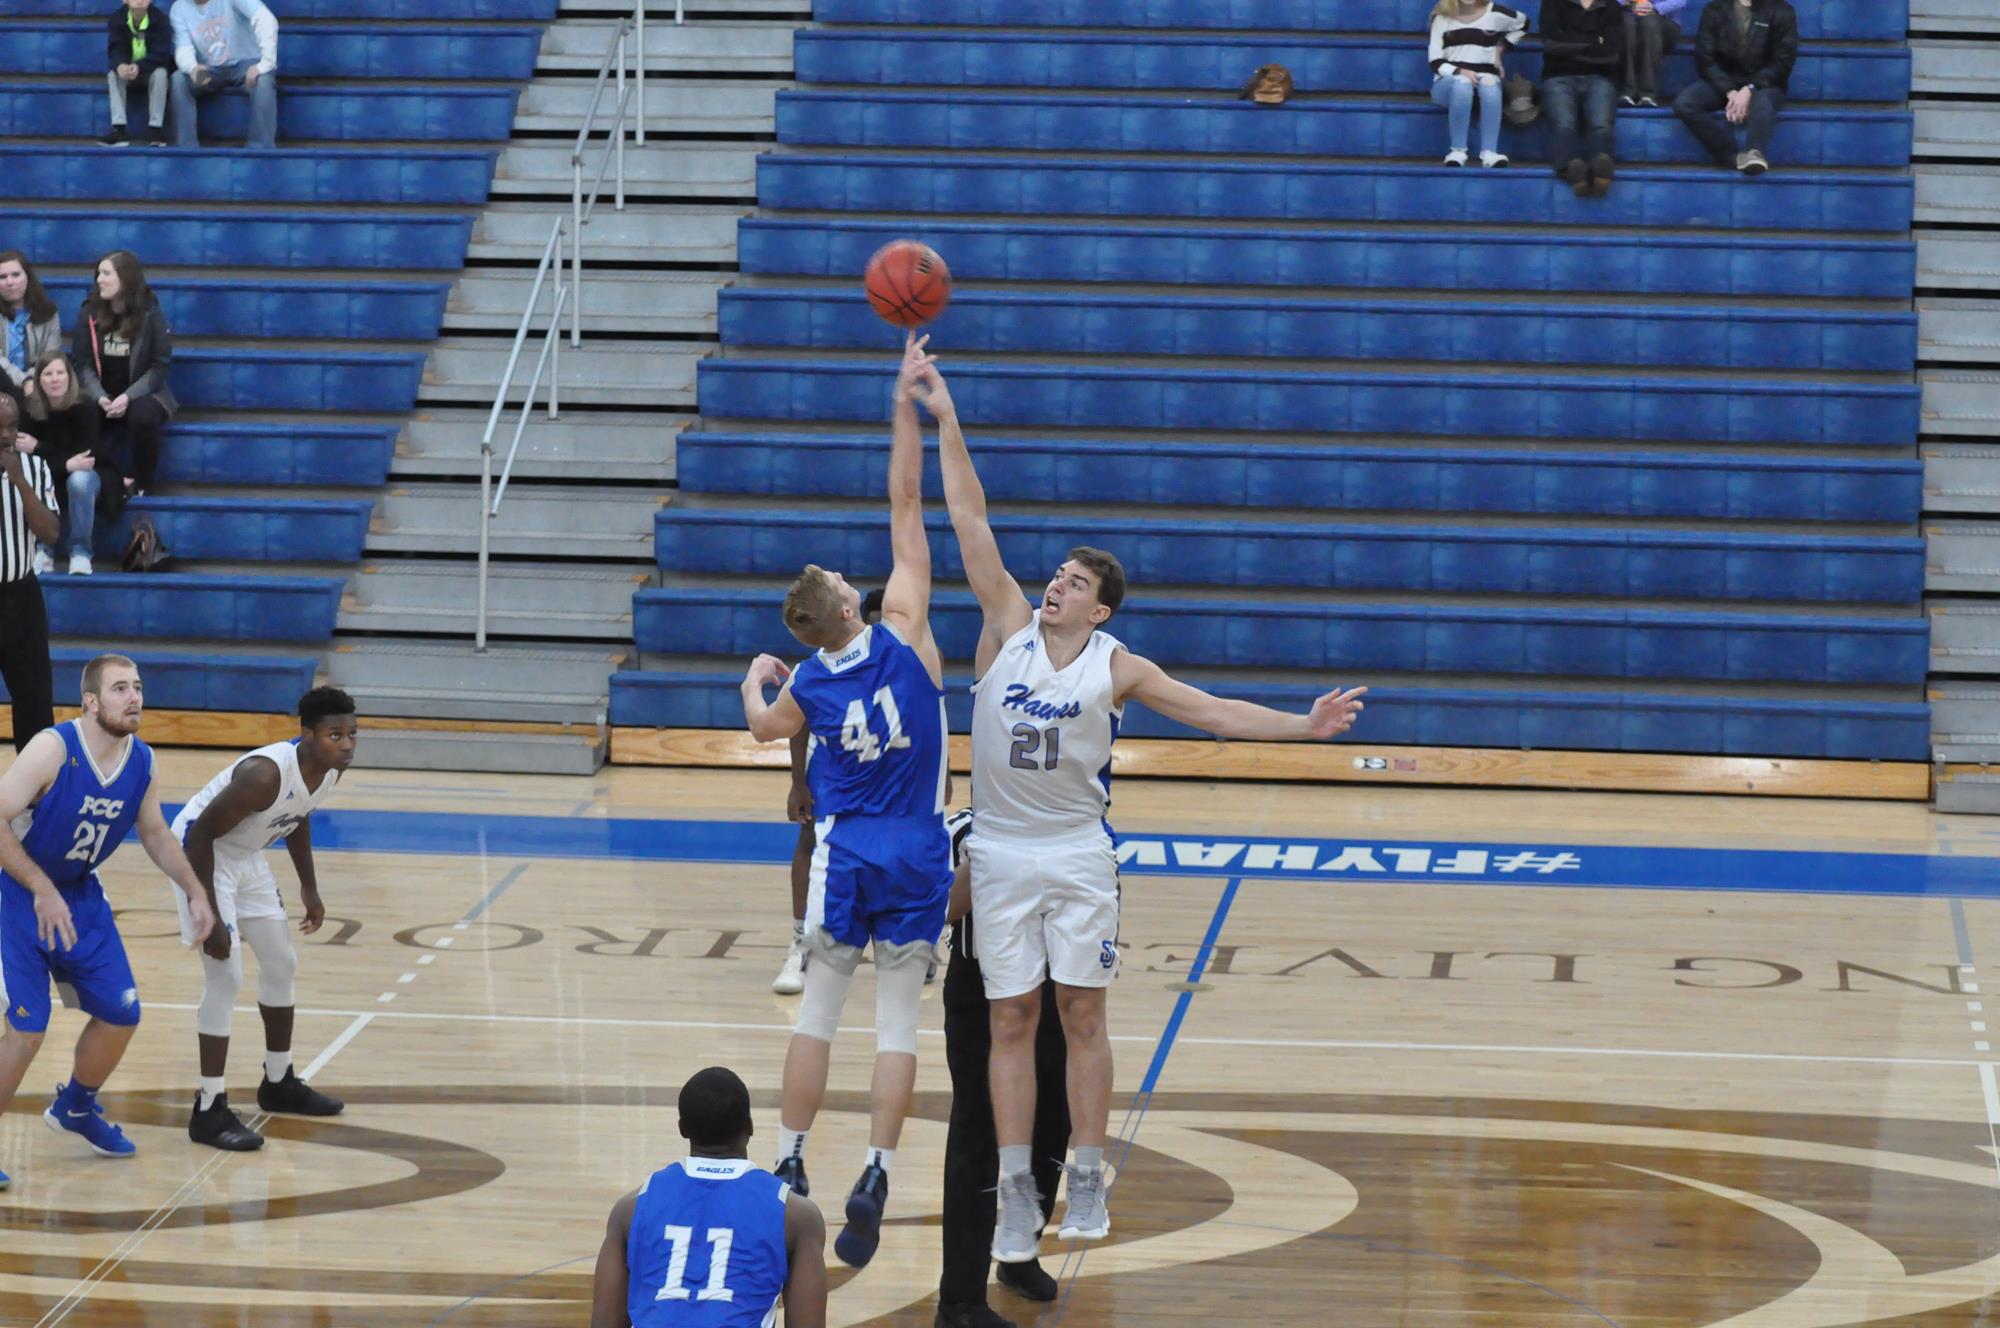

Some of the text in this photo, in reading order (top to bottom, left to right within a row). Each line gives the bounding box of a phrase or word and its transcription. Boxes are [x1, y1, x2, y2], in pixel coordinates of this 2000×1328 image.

[840, 684, 912, 763] 41
[1009, 722, 1060, 771] 21
[65, 820, 110, 864] 21
[1117, 840, 1581, 874] #FLYHAW
[1118, 942, 1594, 984] LIVE
[1658, 956, 2000, 996] NG
[654, 1224, 735, 1303] 11
